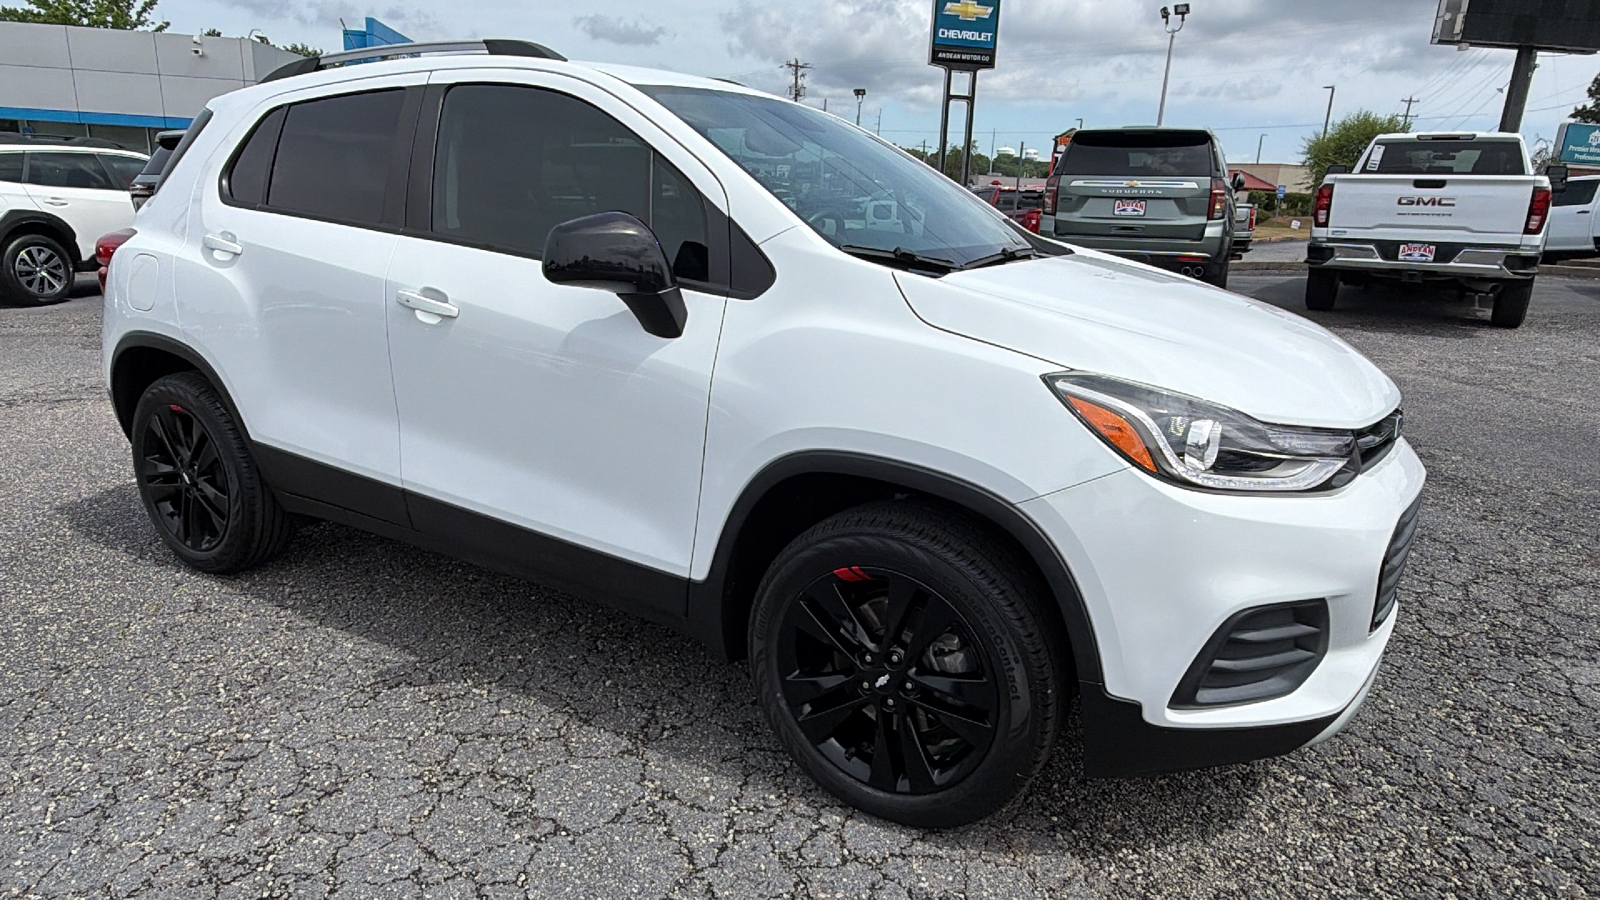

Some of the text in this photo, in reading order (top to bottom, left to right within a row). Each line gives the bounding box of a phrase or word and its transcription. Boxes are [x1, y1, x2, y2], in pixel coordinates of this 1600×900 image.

[938, 28, 993, 41] CHEVROLET
[938, 52, 990, 62] ANDEAN MOTOR CO
[1397, 196, 1456, 207] GMC
[1401, 246, 1434, 256] ANDEAN
